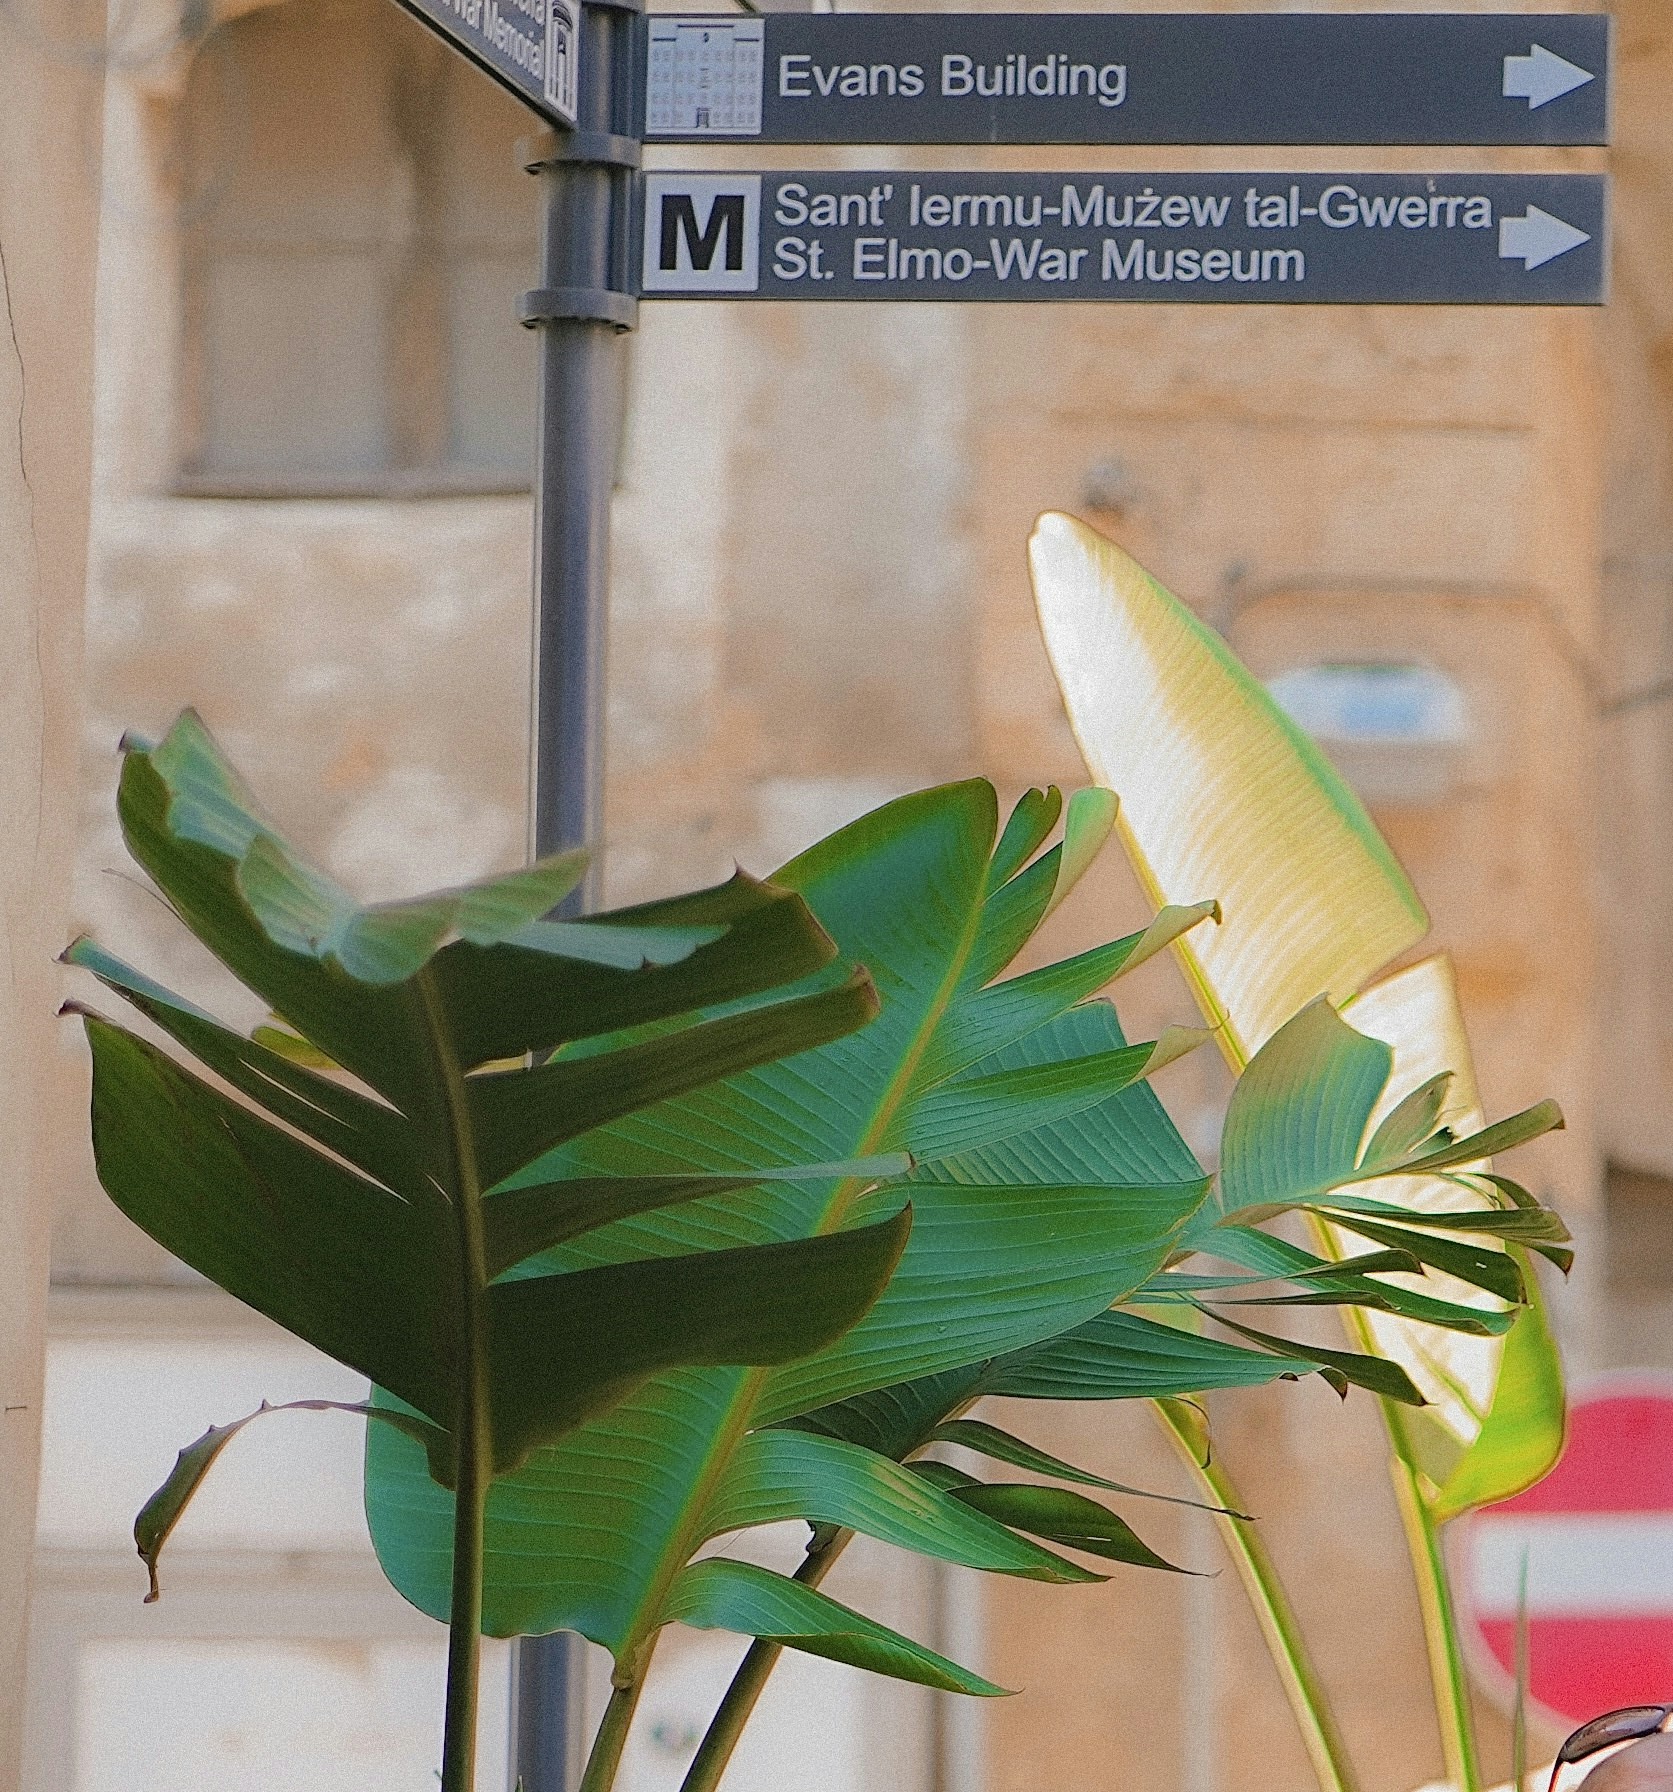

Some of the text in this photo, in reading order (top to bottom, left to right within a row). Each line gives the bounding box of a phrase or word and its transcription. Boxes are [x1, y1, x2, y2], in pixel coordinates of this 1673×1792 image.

[484, 0, 545, 81] Memorial
[779, 54, 1126, 106] Evans Building
[774, 183, 1492, 228] Sant' Iermu-Mużew tal-Gwerra
[659, 194, 744, 271] M
[773, 236, 1305, 282] St. Elmo-War Museum
